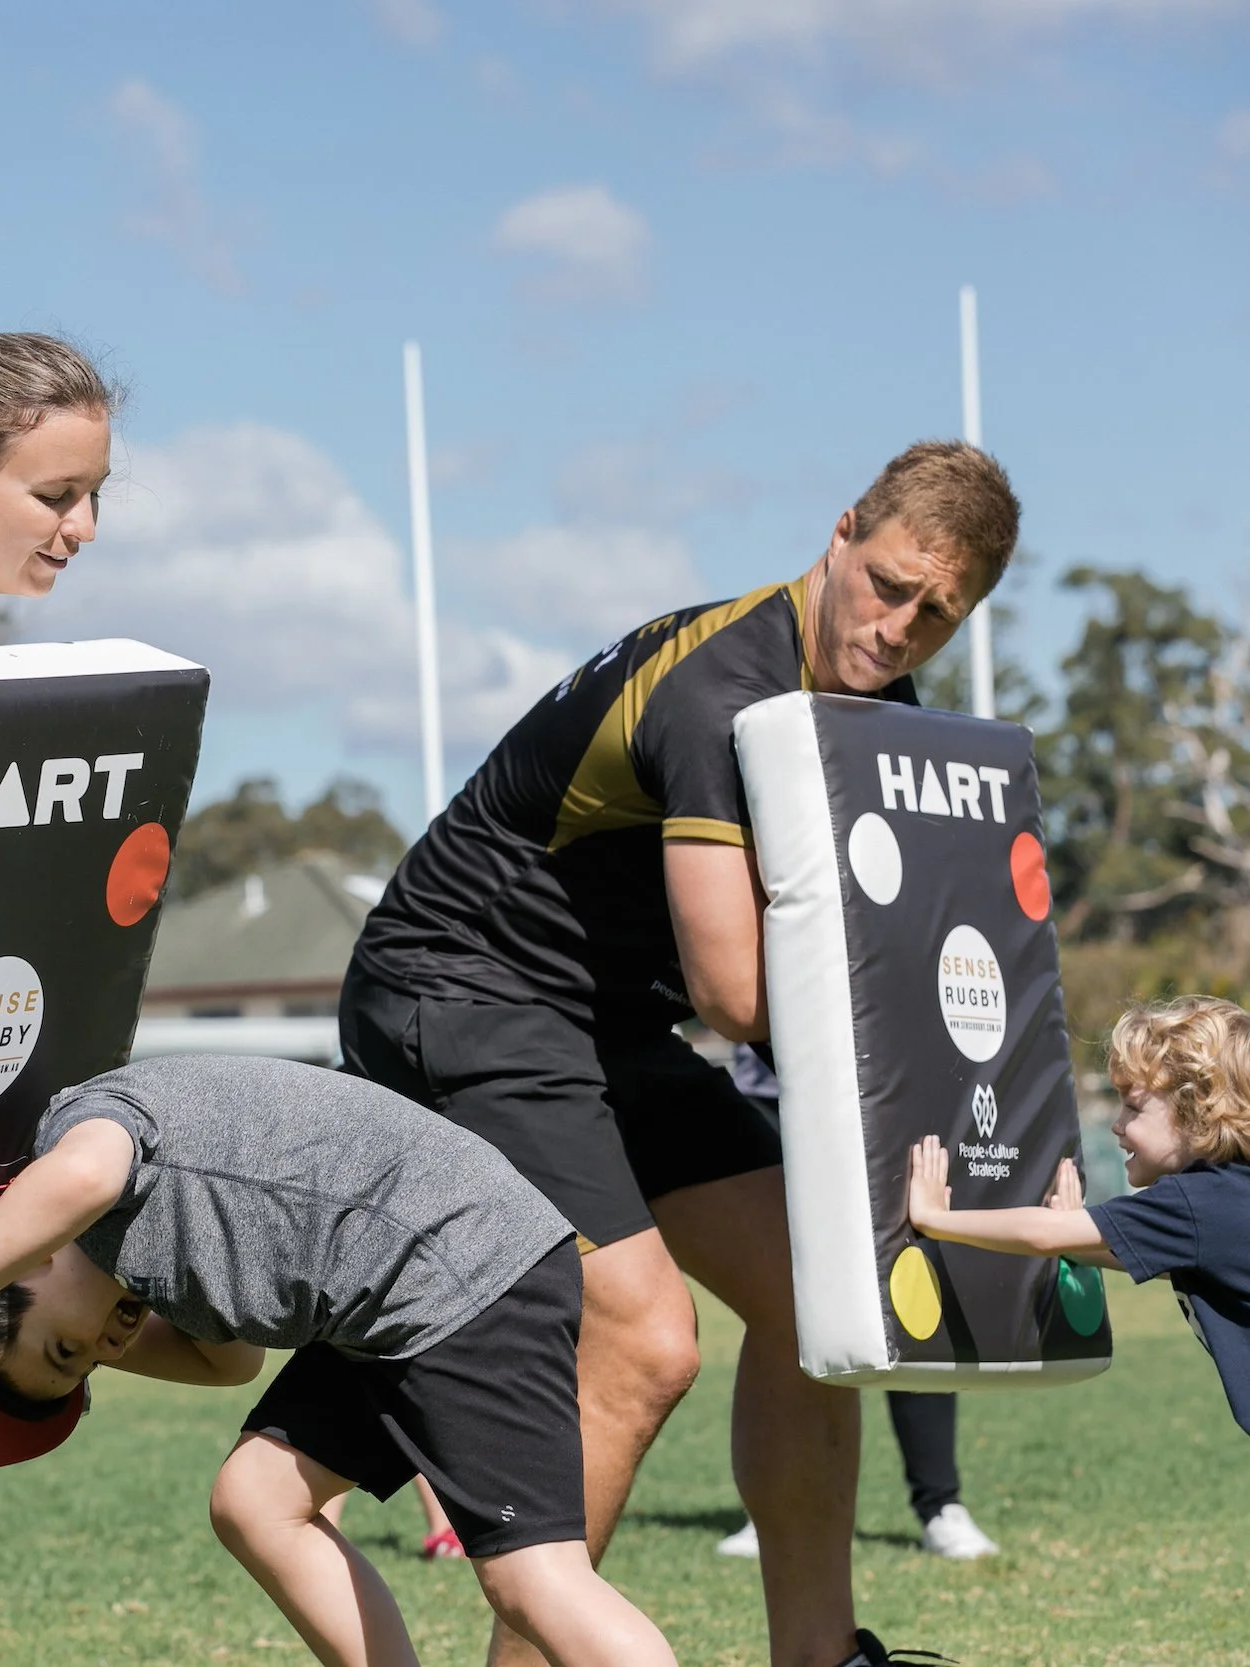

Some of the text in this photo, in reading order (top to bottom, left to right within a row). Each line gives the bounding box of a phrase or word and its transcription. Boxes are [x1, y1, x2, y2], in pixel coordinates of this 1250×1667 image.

[877, 753, 1010, 824] HART
[942, 955, 998, 979] SENSE
[945, 986, 999, 1009] RUGBY
[967, 1161, 1011, 1181] Strategies
